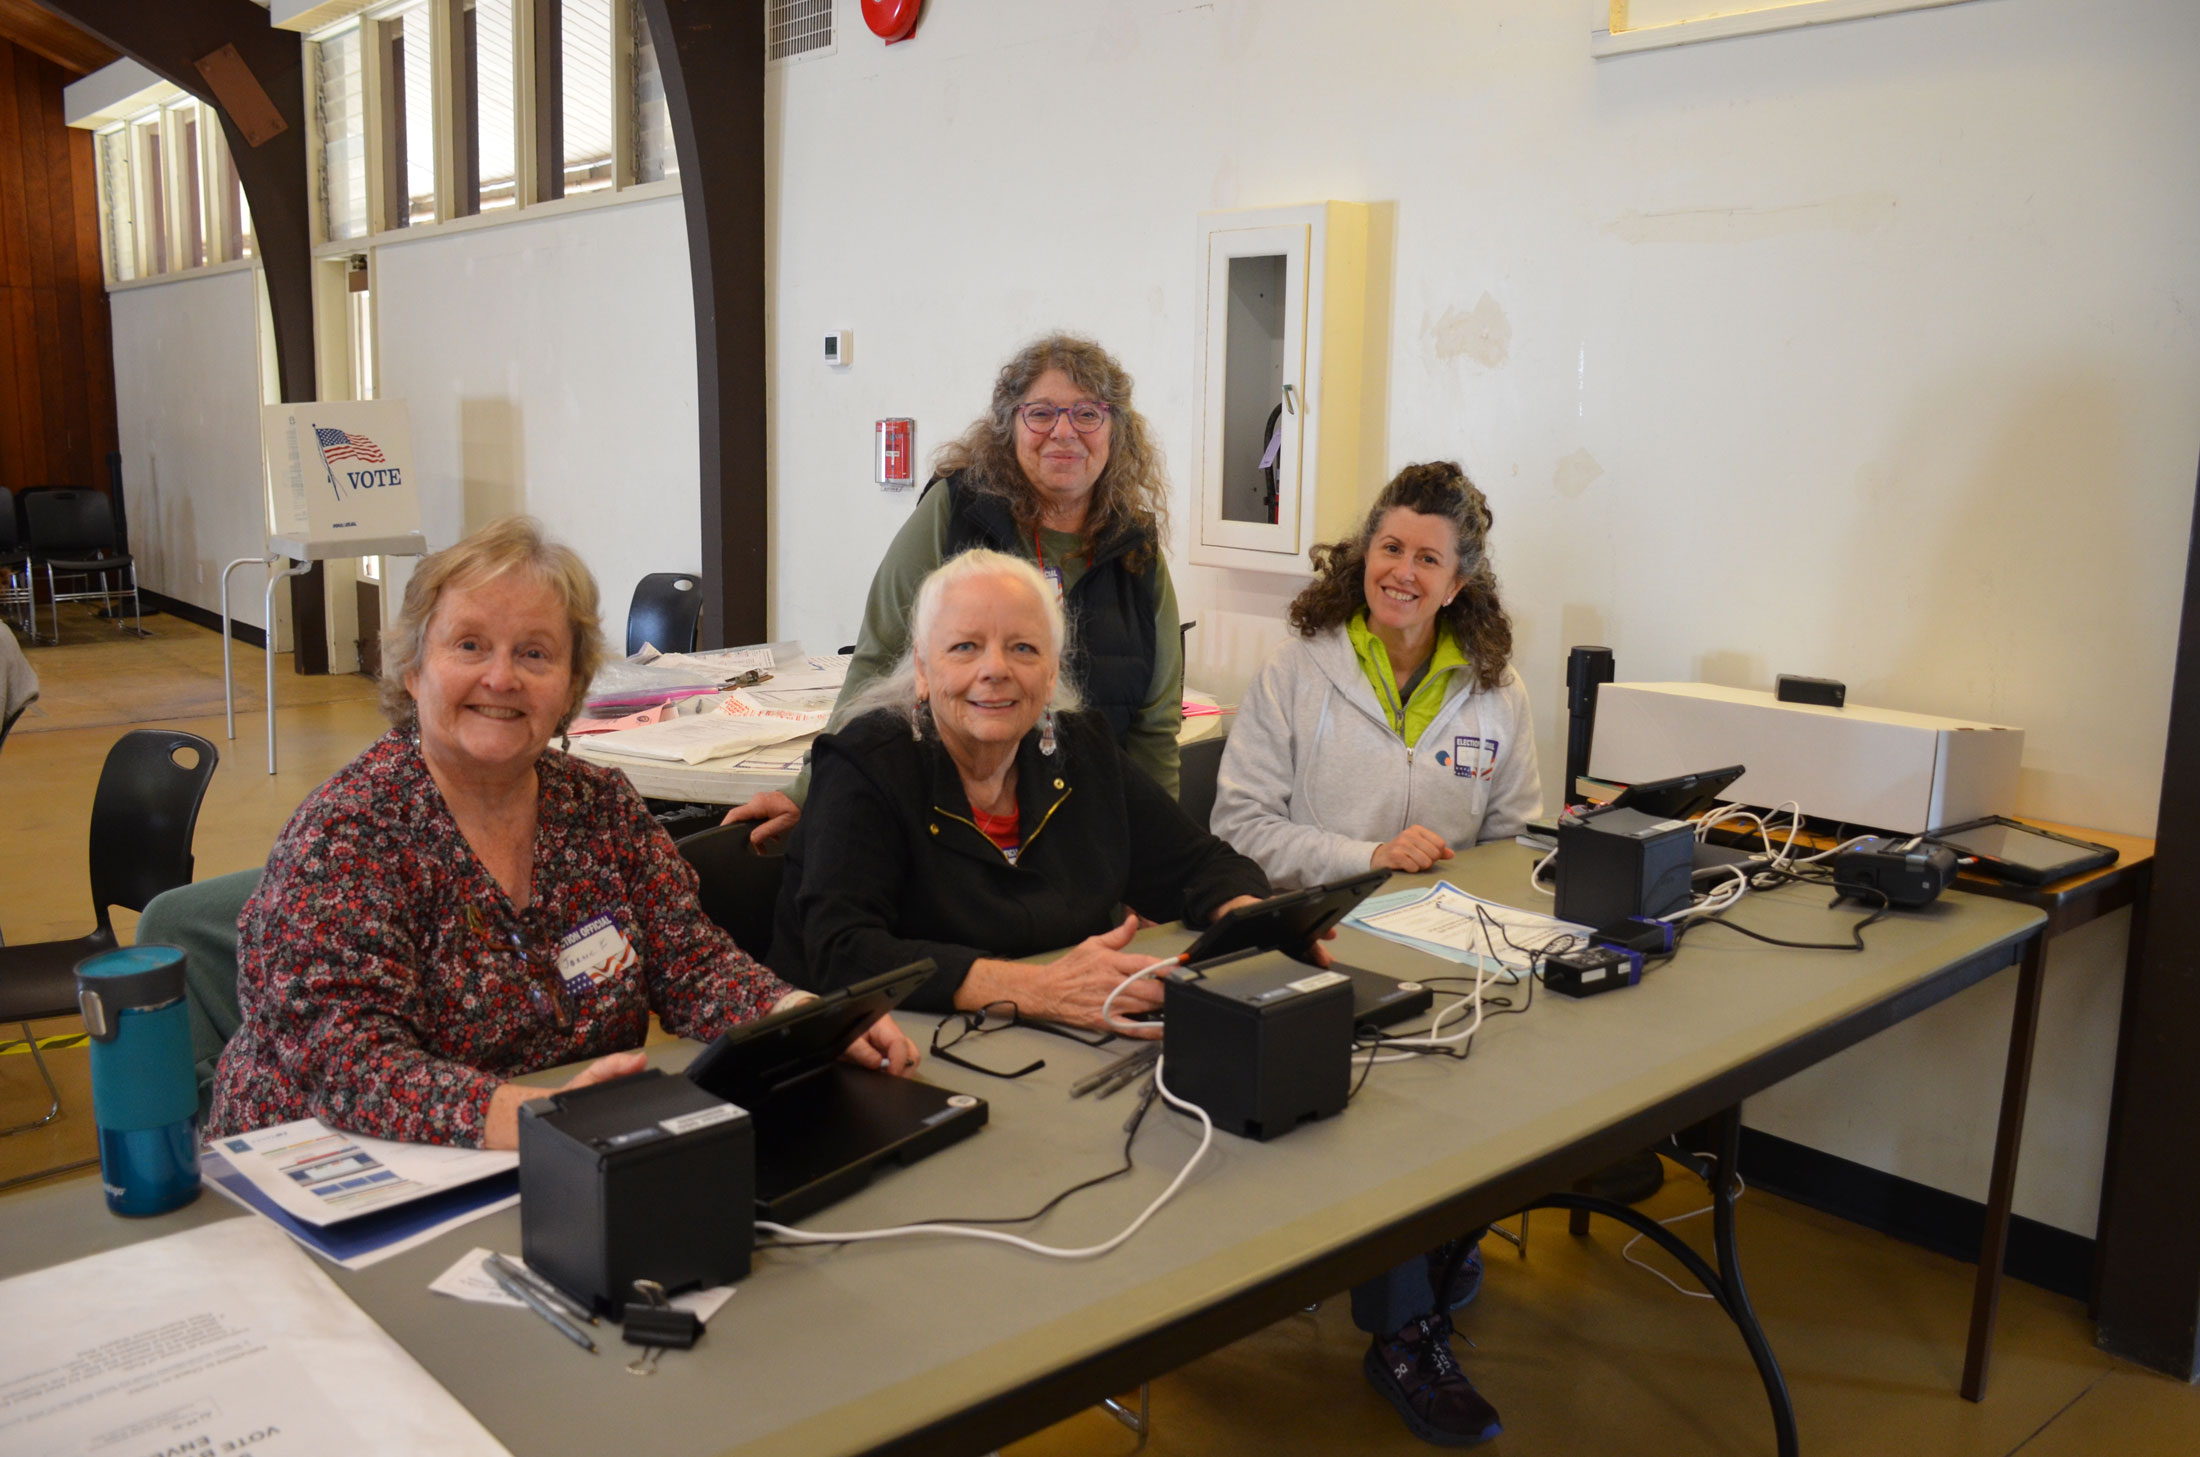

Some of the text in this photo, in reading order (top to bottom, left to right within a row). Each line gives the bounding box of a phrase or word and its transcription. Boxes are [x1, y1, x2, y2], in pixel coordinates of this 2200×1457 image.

[347, 468, 402, 490] VOTE
[580, 915, 612, 937] OFFICIAL
[220, 1426, 281, 1453] VOTE
